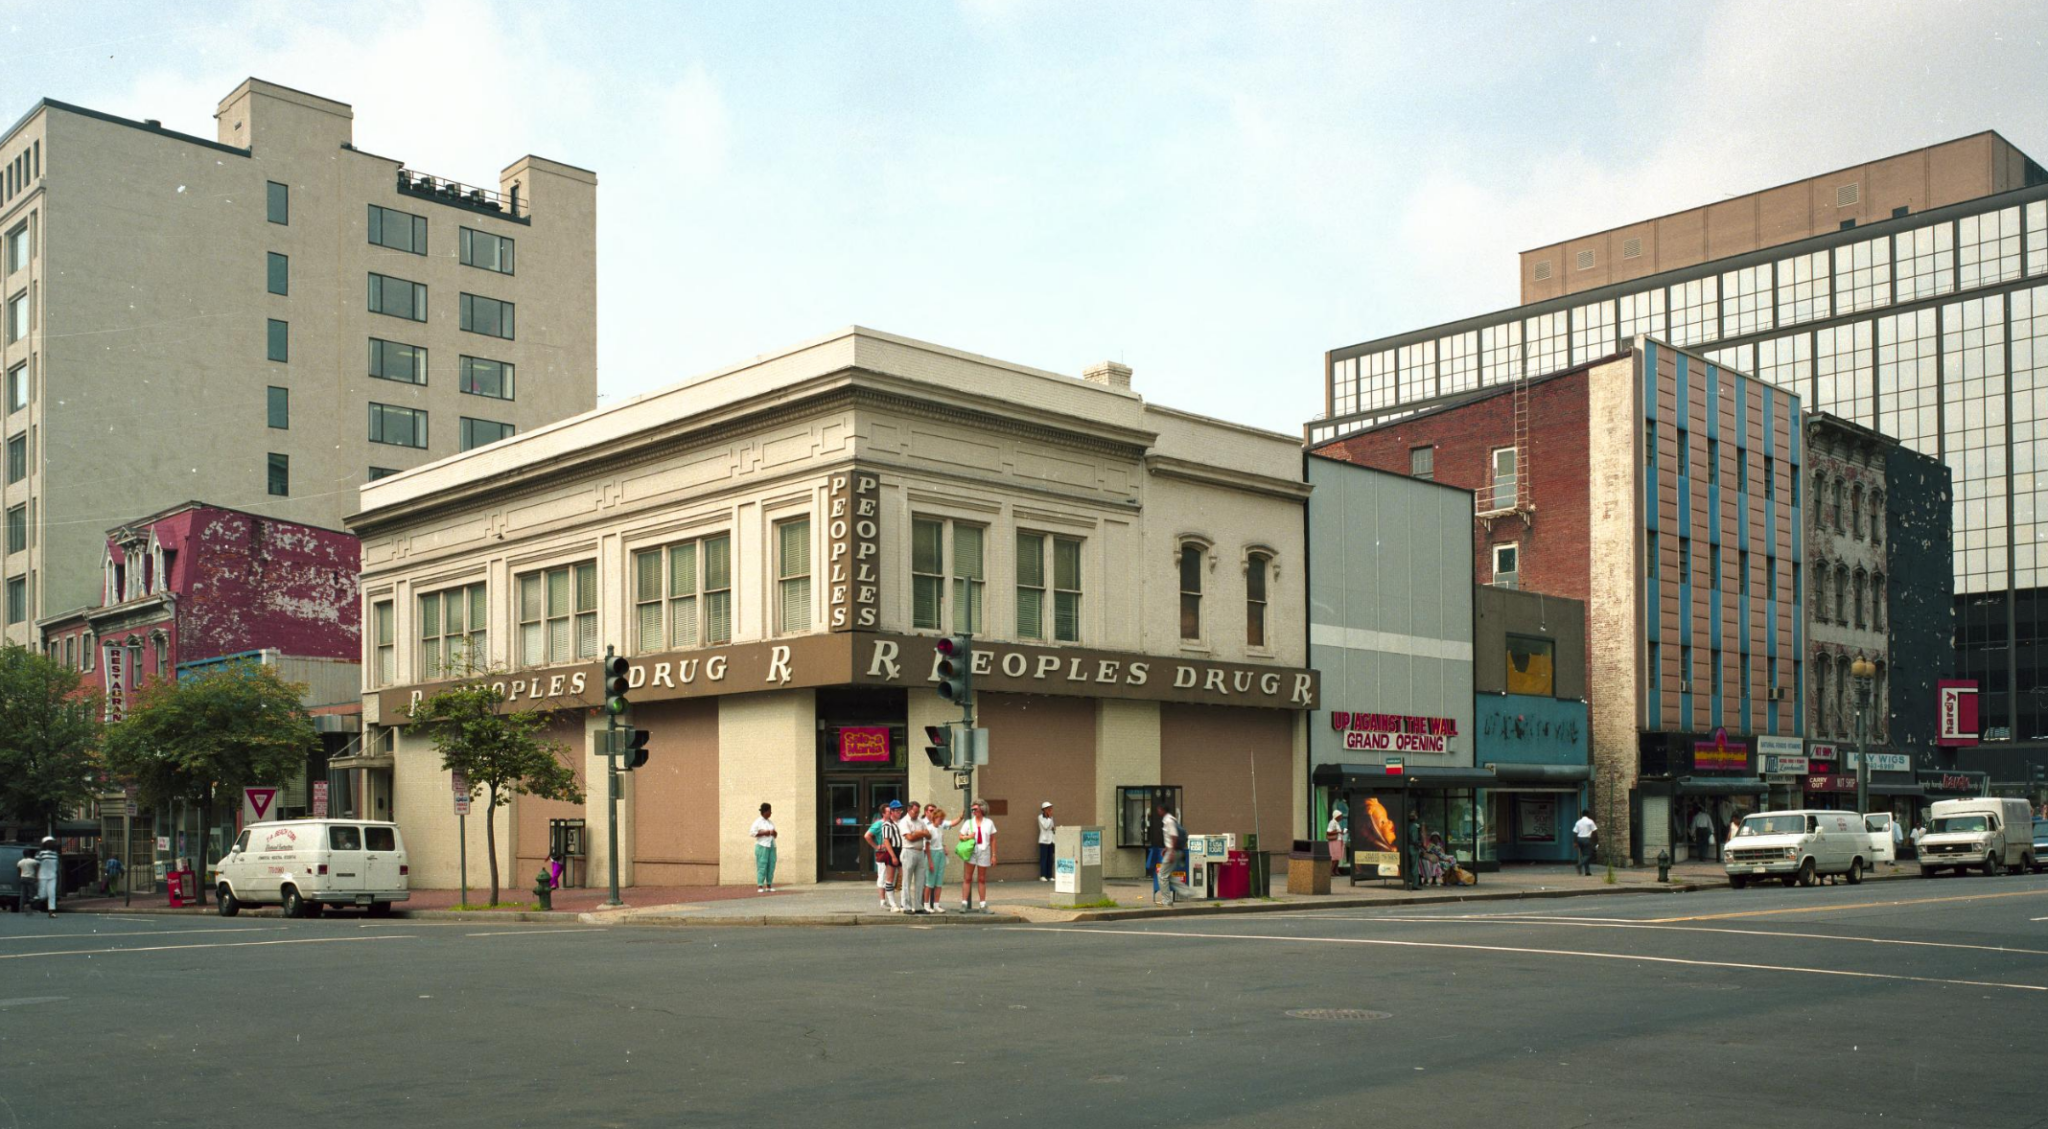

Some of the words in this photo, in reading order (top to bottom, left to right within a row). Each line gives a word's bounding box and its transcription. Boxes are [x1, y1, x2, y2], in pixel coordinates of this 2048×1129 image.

[830, 476, 847, 627] PEOPLES
[856, 476, 877, 626] PEOPLES
[111, 650, 122, 722] RESTAURAN
[629, 655, 728, 689] DRUG
[1173, 665, 1280, 695] DRUG
[1333, 711, 1350, 730] UP
[1354, 713, 1402, 733] AGAINST
[1406, 715, 1427, 734] THE
[1430, 717, 1458, 736] WALL
[1945, 691, 1956, 735] hardy
[1347, 732, 1389, 749] GRAND
[1396, 734, 1443, 751] OPENING
[1854, 753, 1874, 763] KY
[1879, 755, 1905, 764] WIGS
